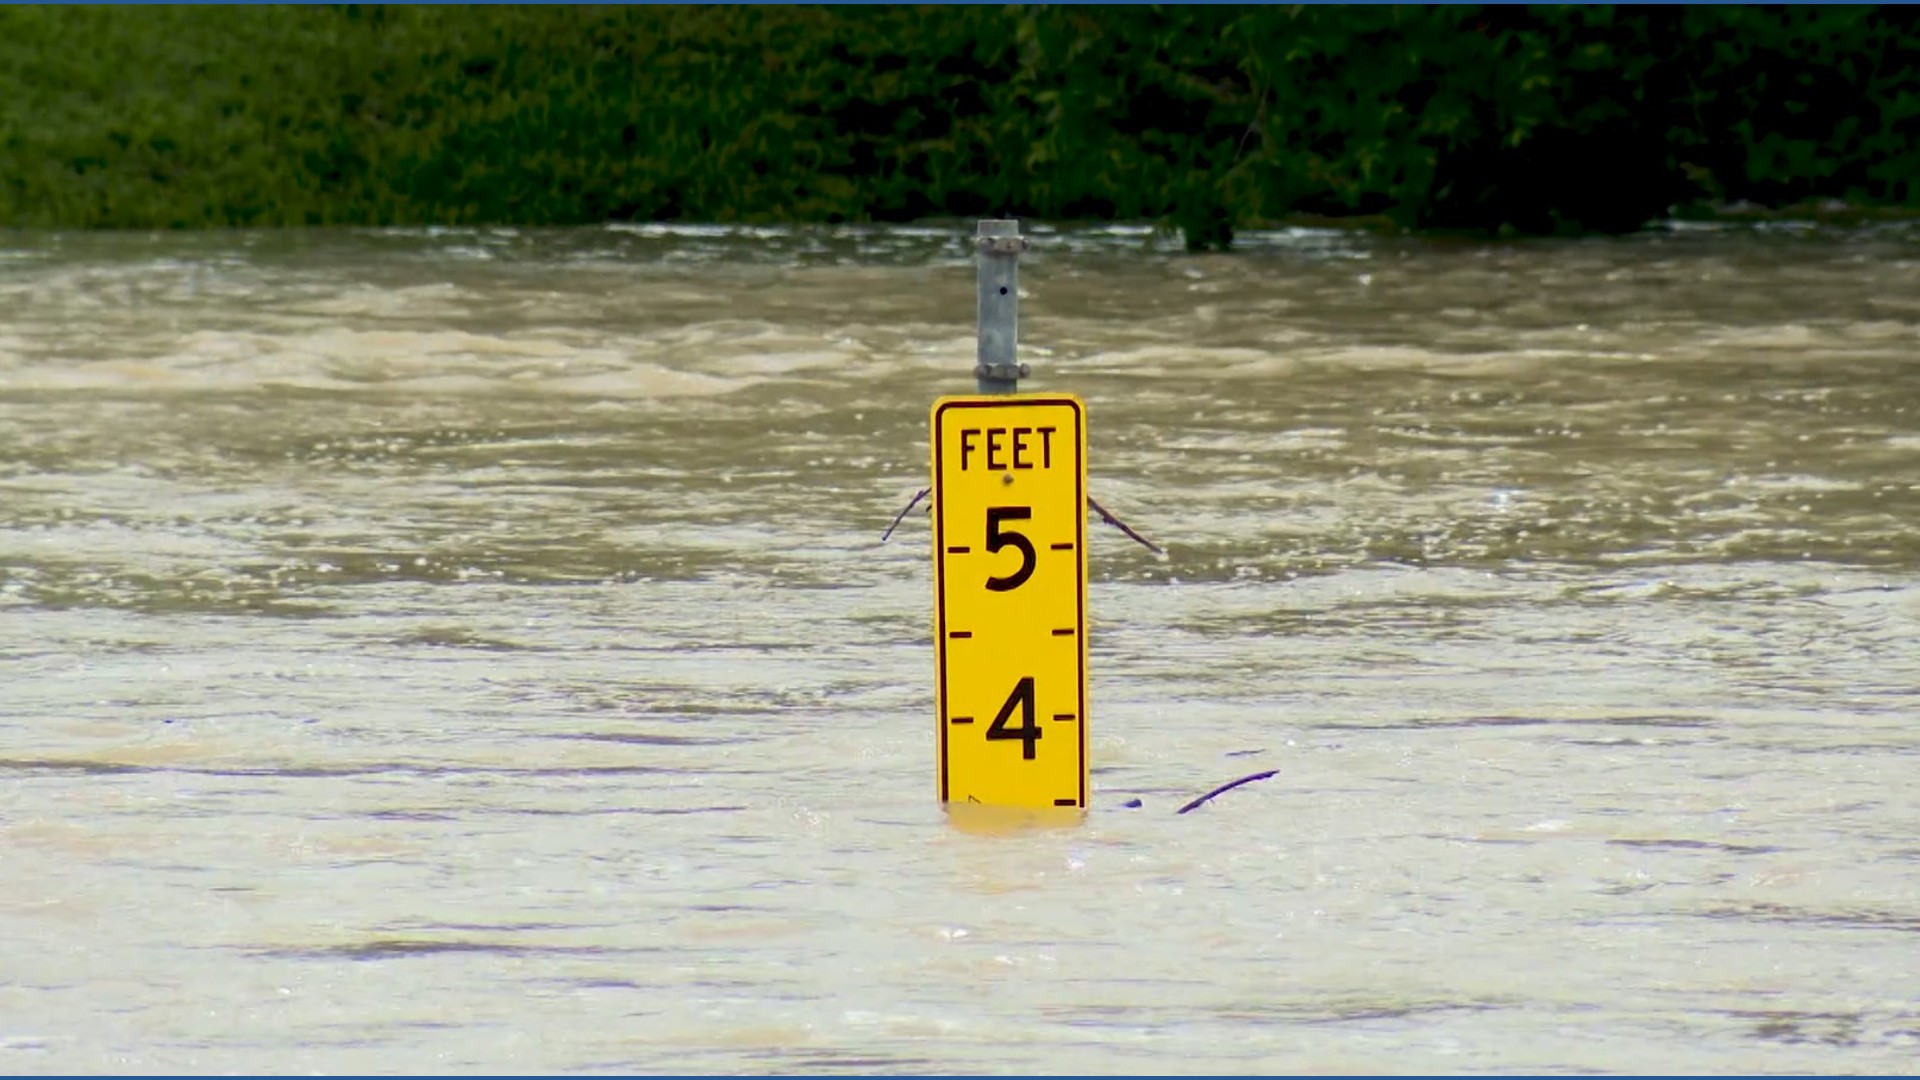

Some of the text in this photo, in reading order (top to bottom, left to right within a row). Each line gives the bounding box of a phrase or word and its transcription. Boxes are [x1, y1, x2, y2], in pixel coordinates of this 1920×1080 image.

[961, 427, 1056, 471] FEET
[985, 506, 1037, 592] 5
[986, 676, 1042, 760] 4
